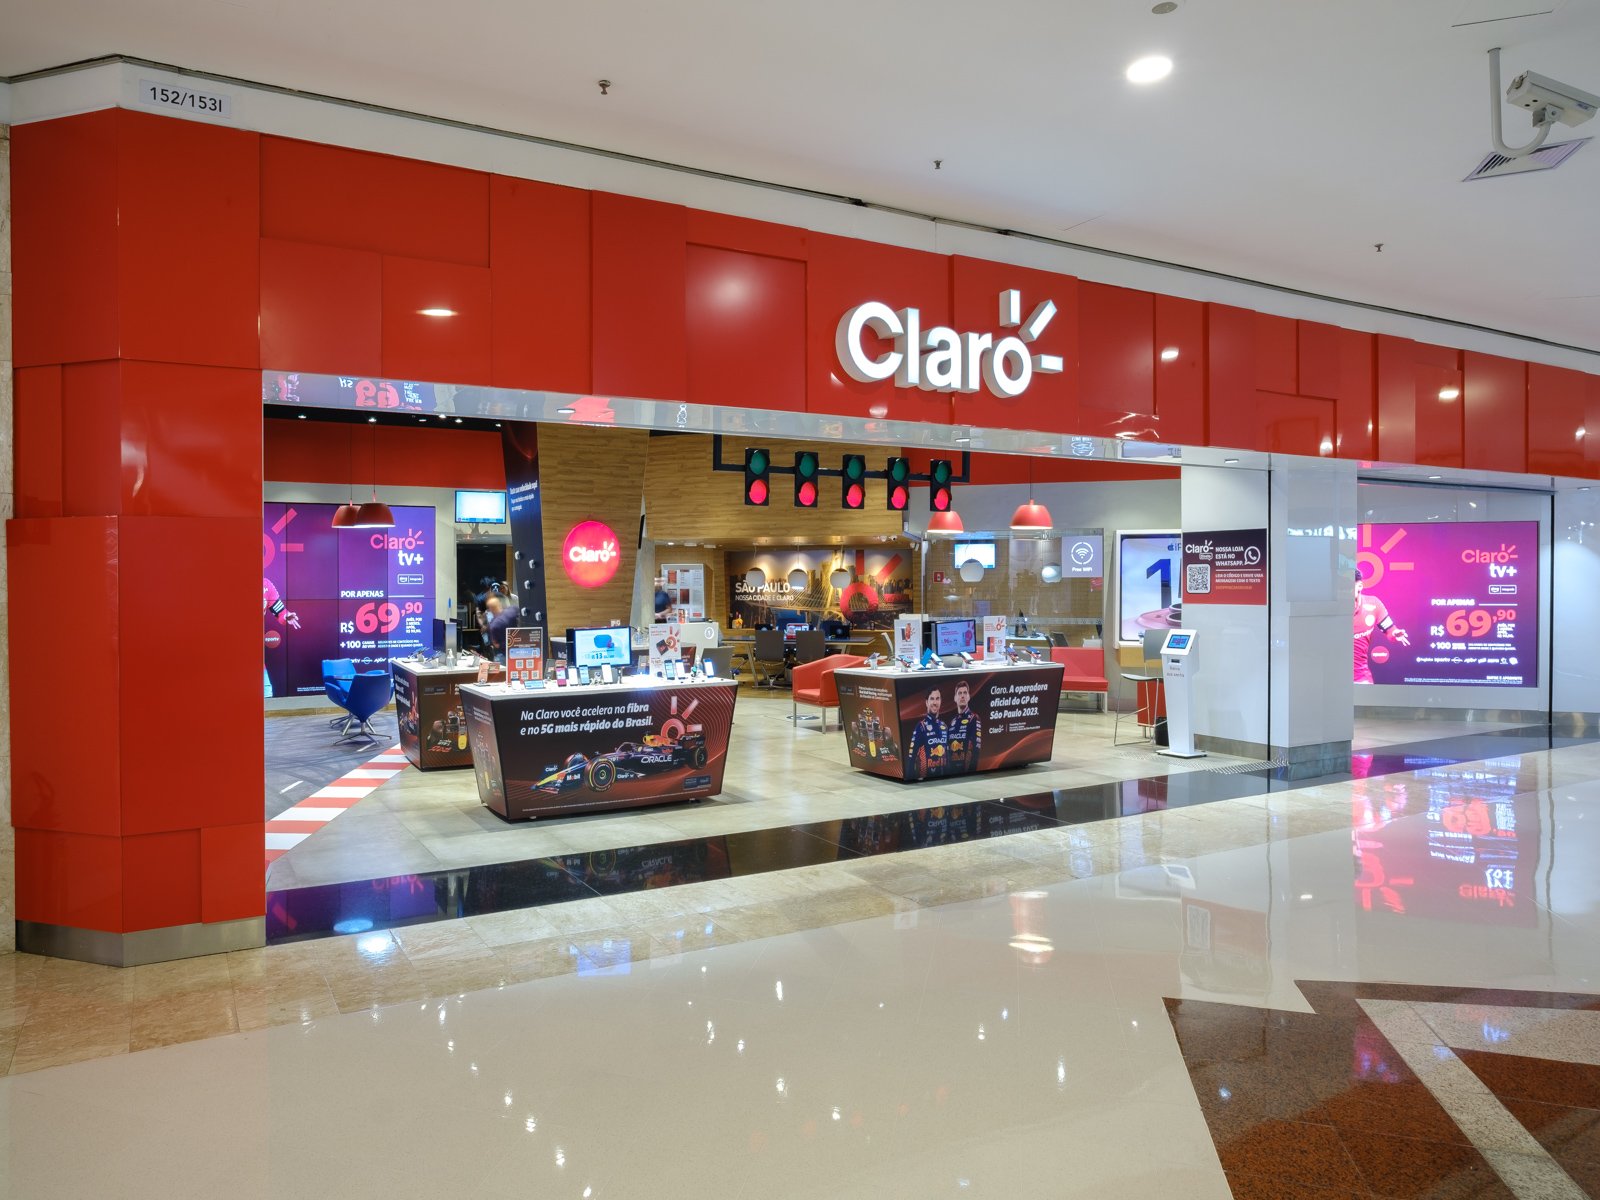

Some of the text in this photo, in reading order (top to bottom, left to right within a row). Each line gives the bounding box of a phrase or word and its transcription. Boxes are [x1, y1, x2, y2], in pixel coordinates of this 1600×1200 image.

[836, 297, 1048, 398] Claro
[370, 531, 420, 550] Claro
[1186, 542, 1212, 554] Claro
[398, 550, 424, 566] tv+
[569, 544, 613, 562] Claro
[1462, 547, 1514, 563] Claro
[1489, 563, 1518, 578] tv+
[340, 621, 354, 634] R$
[1431, 625, 1444, 637] R$
[990, 683, 1048, 695] Claro. A operadora
[990, 695, 1038, 707] oficial do GP de
[520, 711, 534, 720] Na
[536, 710, 559, 720] Claro
[560, 707, 581, 718] você
[582, 706, 612, 716] acelera
[627, 703, 649, 713] fibra
[990, 707, 1039, 720] São Paulo 2023.
[527, 727, 540, 735] no
[541, 724, 553, 734] 5G
[555, 722, 578, 733] mais
[579, 719, 611, 732] rápido
[612, 718, 624, 729] do
[626, 716, 653, 728] Brasil.
[641, 755, 672, 763] ORACLE
